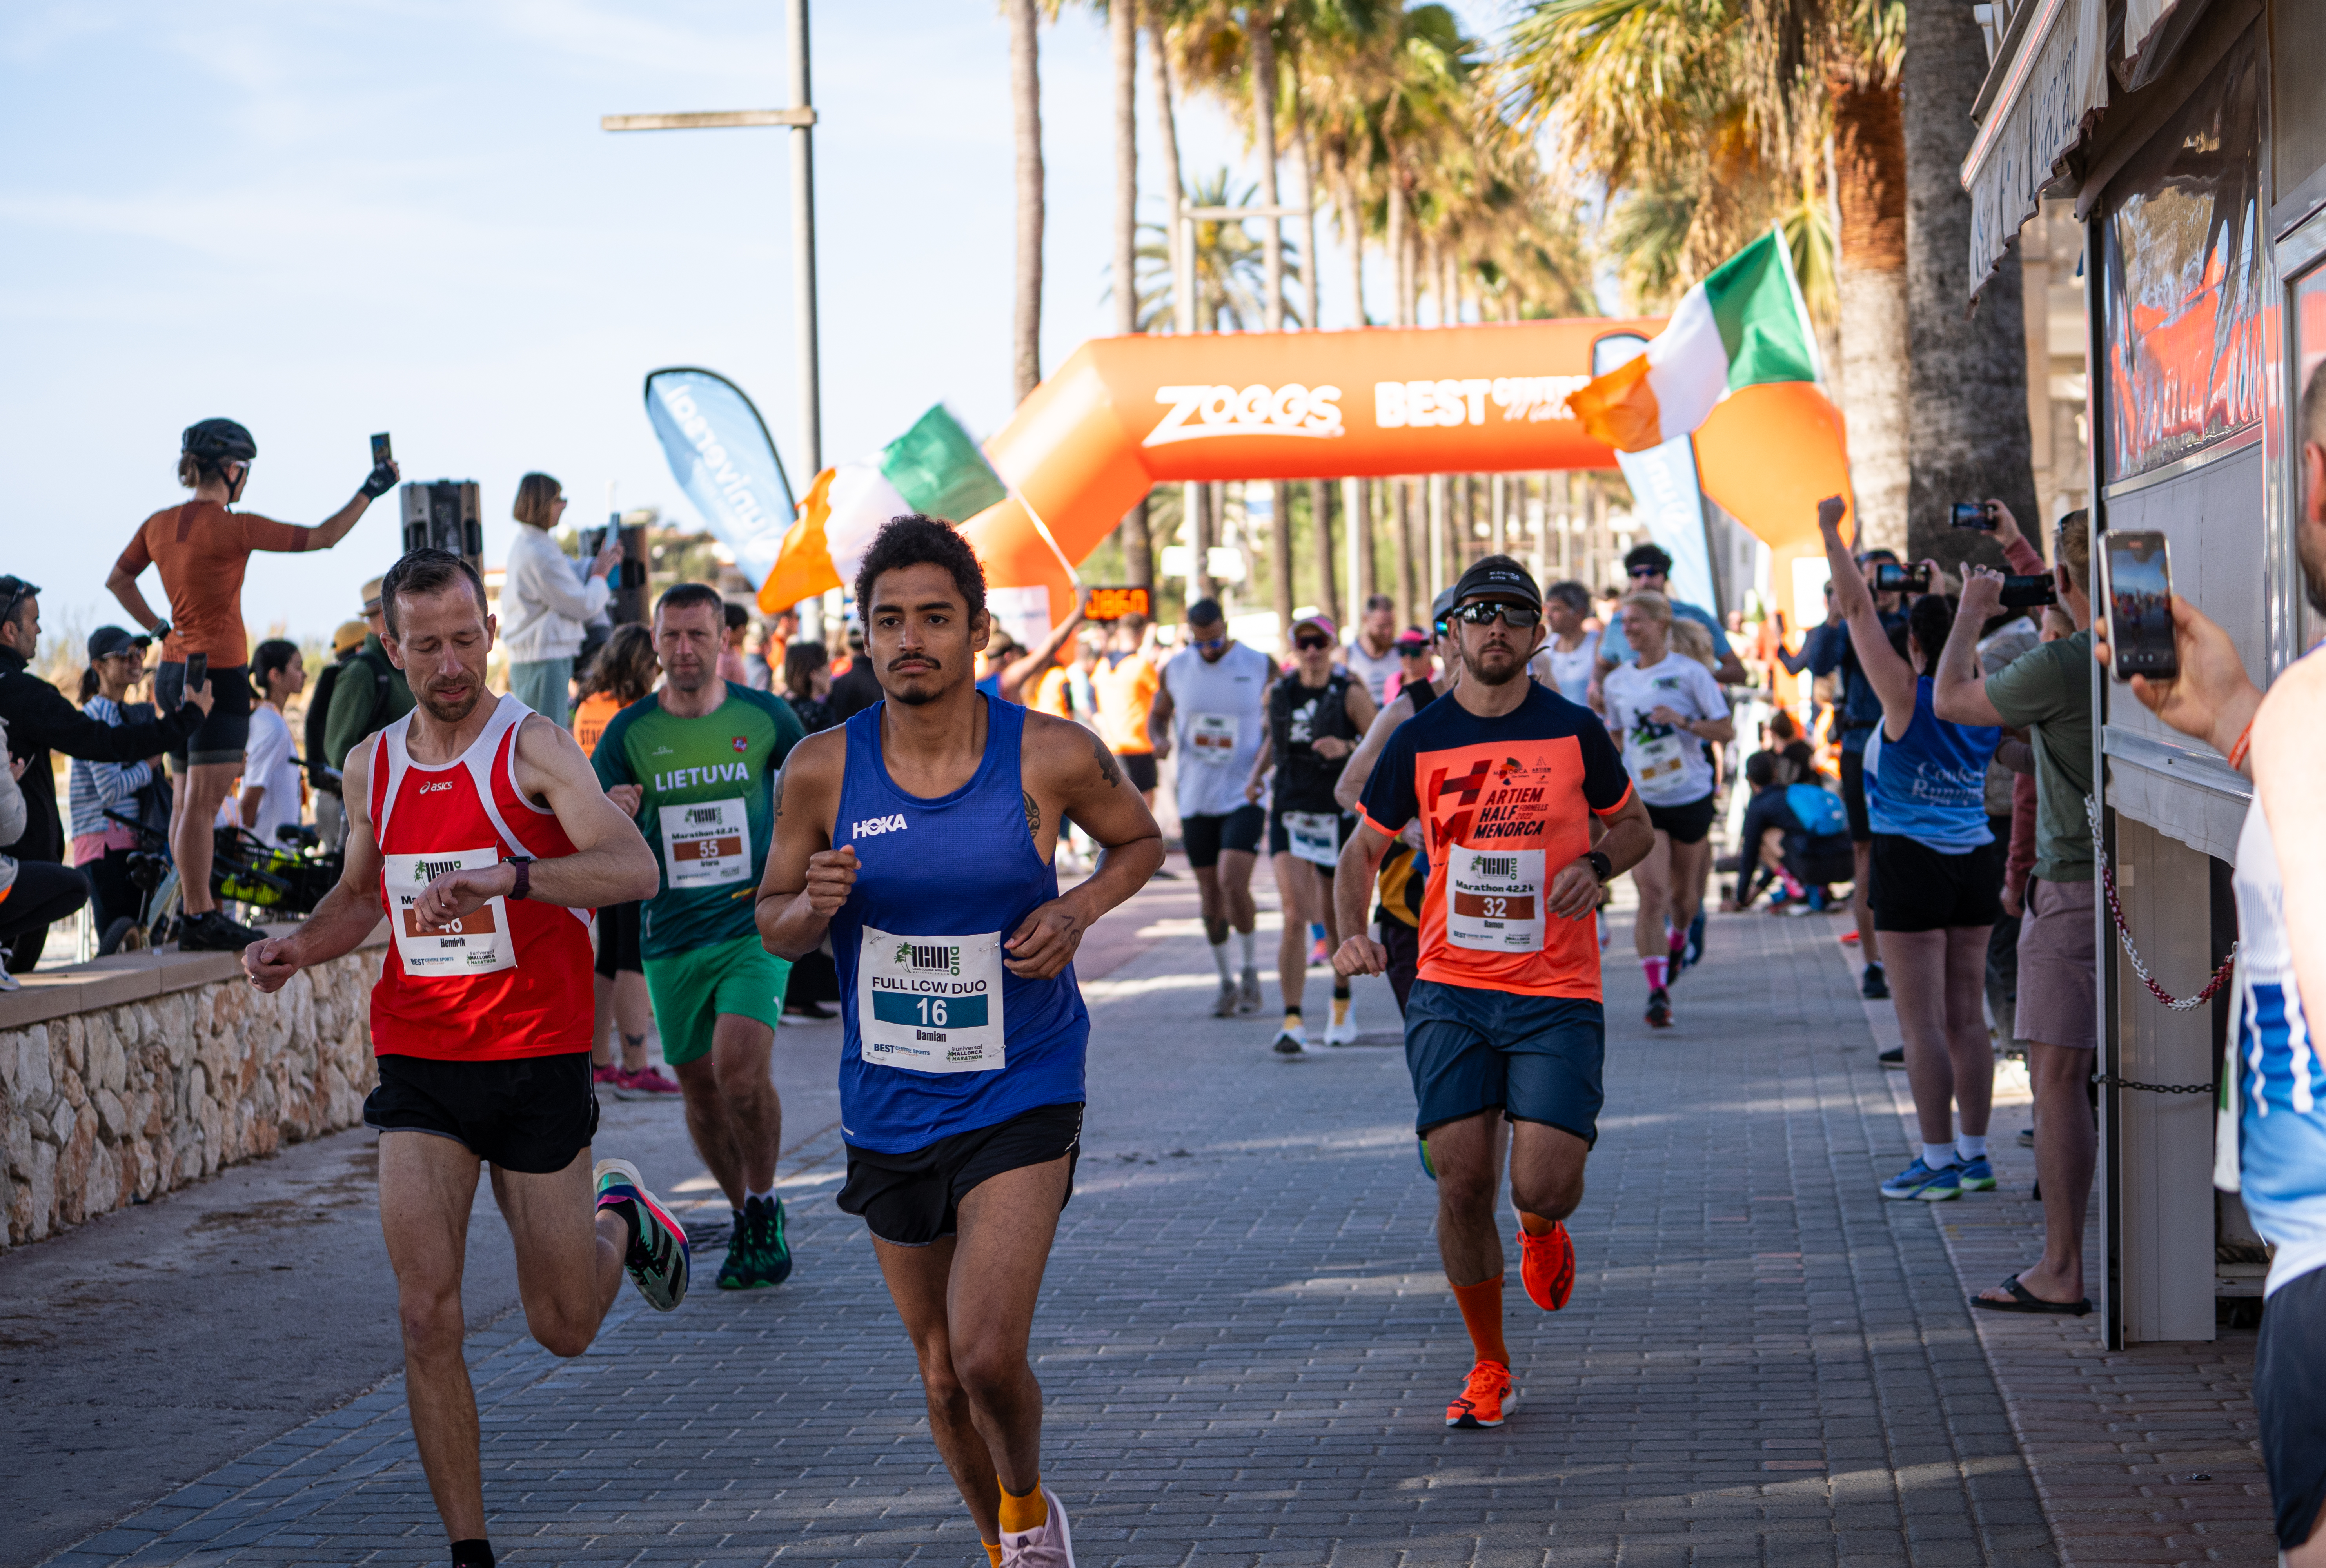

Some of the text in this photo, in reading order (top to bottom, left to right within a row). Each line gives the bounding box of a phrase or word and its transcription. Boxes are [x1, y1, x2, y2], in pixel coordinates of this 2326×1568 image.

[1374, 379, 1491, 428] BEST
[1141, 383, 1343, 448] ZOGGS
[655, 762, 749, 792] LIETUVA
[1485, 787, 1545, 806] ARTIEM
[1479, 805, 1519, 823] HALF
[672, 829, 714, 840] Marathon
[853, 813, 908, 839] HOKA
[1473, 820, 1545, 839] MENORCA
[699, 840, 719, 858] 55
[1456, 879, 1504, 892] Marathon
[1483, 897, 1507, 917] 32
[1484, 920, 1504, 929] Ramon
[440, 937, 466, 948] Hendrik
[1454, 930, 1466, 939] BEST
[950, 946, 960, 976] DUO
[872, 976, 987, 994] FULL LCW DUO
[917, 998, 948, 1026] 16
[916, 1029, 946, 1042] Damian
[874, 1043, 895, 1053] BEST
